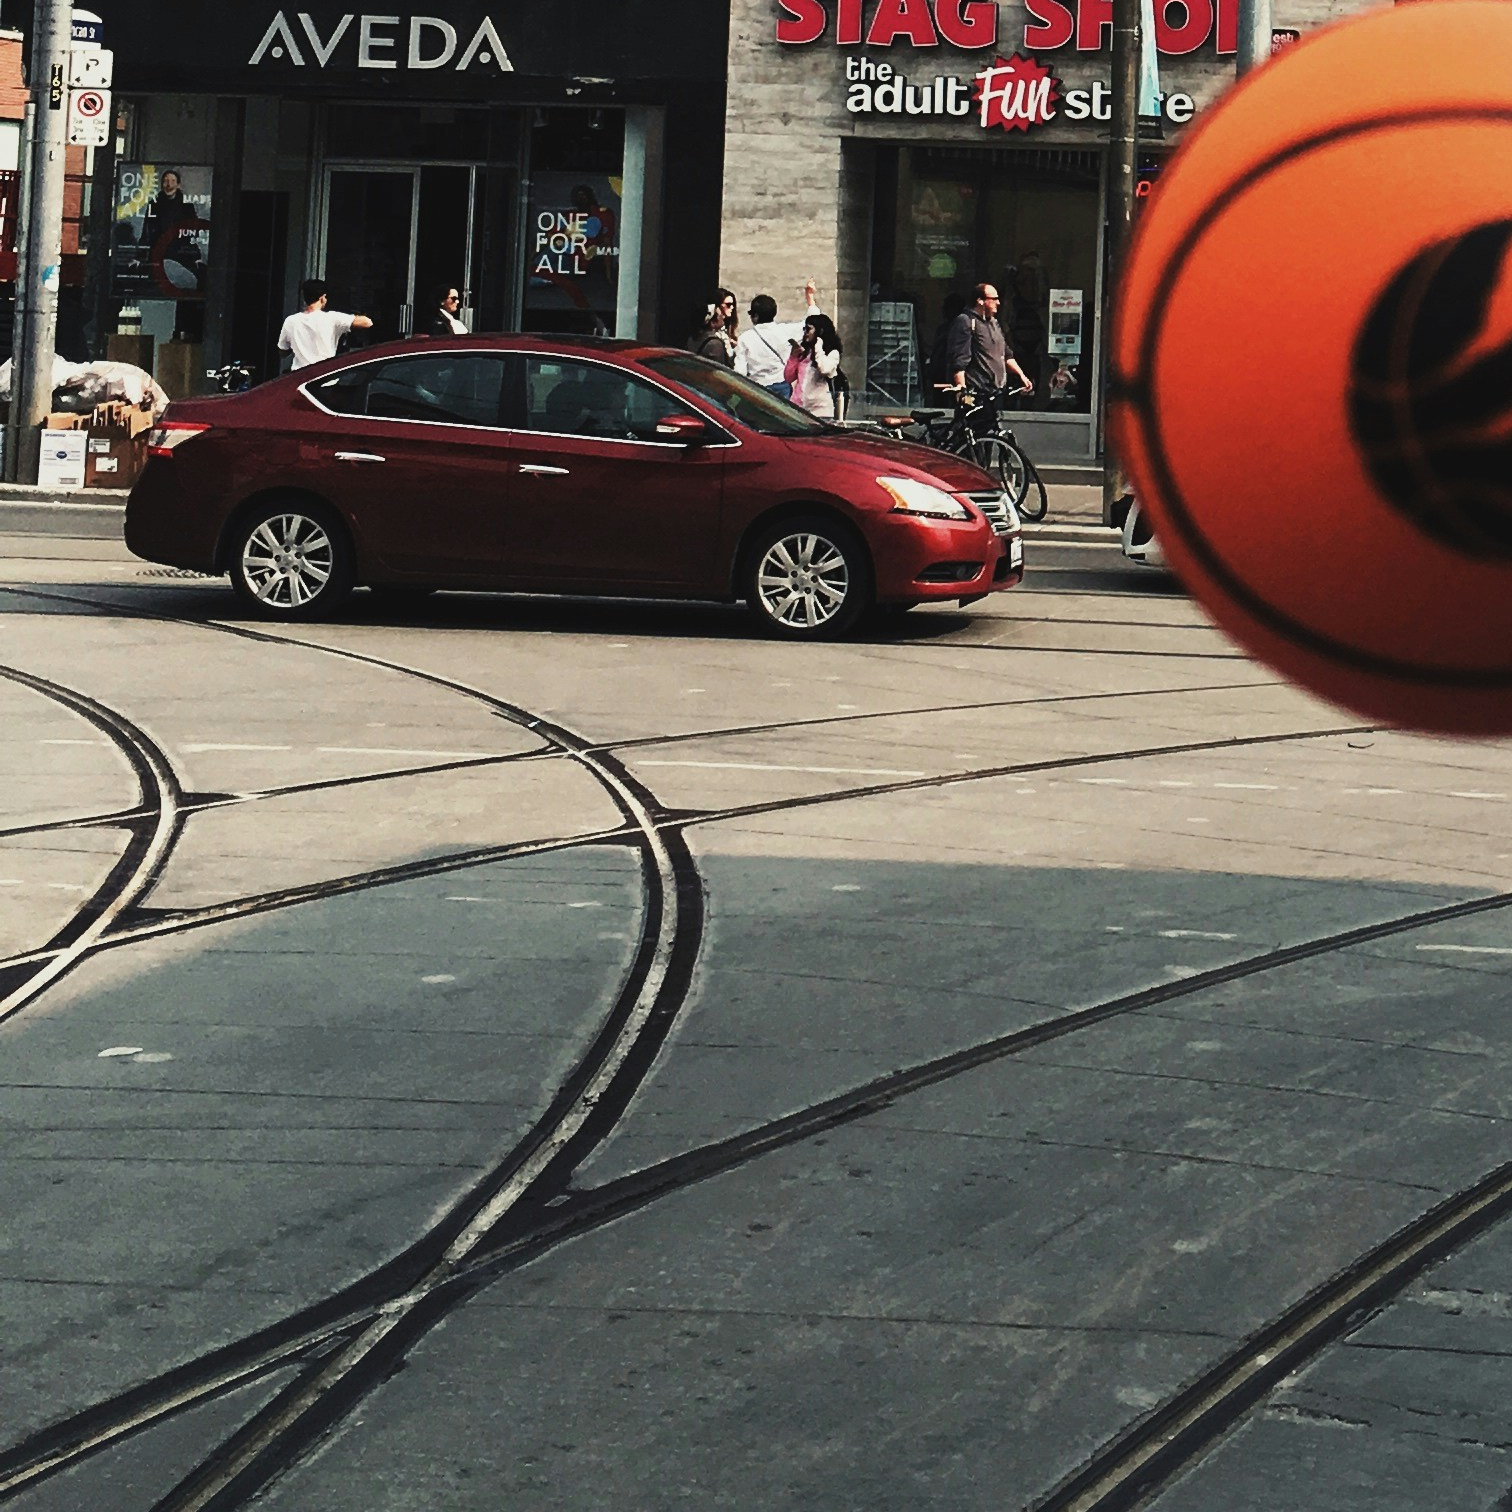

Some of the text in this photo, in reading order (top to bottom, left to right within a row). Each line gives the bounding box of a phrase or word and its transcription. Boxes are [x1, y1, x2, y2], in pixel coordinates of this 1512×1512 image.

[248, 10, 515, 72] AVEDA
[846, 56, 892, 83] the
[846, 66, 1194, 127] adult Fun ste
[121, 172, 159, 187] ONE
[119, 188, 158, 204] FOR
[118, 204, 157, 218] ALL
[537, 212, 589, 231] ONE
[536, 232, 588, 255] FOR
[535, 254, 587, 275] ALL
